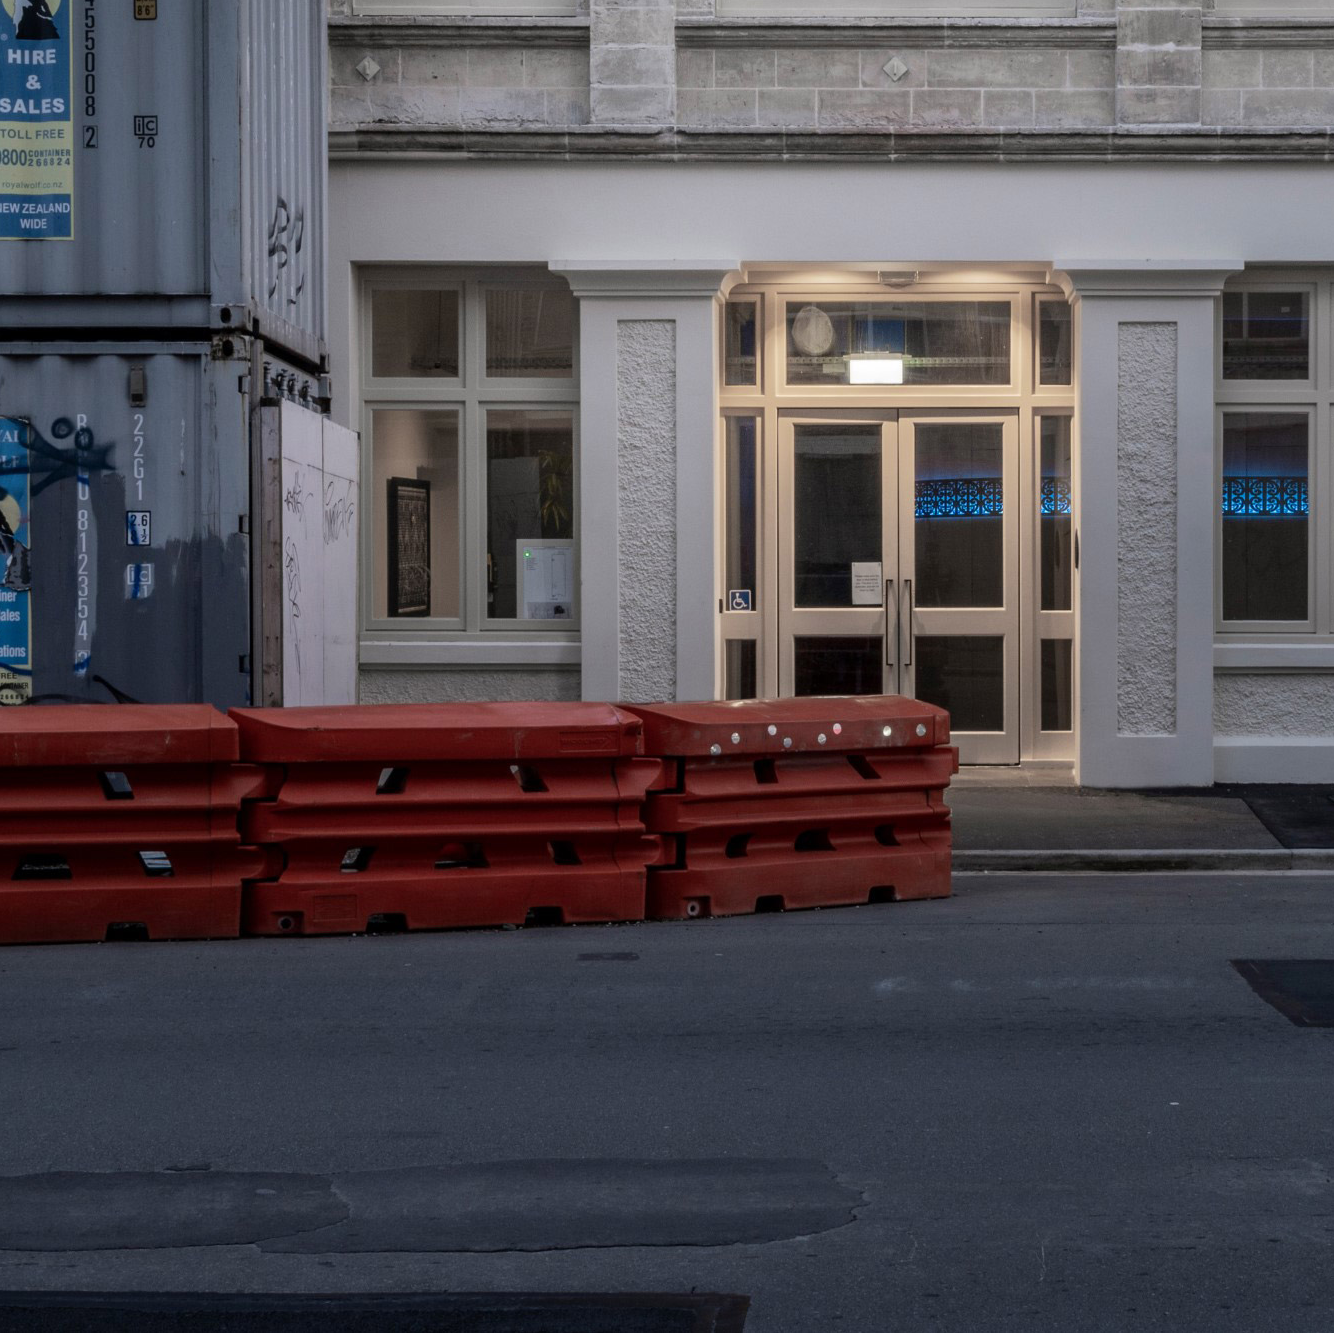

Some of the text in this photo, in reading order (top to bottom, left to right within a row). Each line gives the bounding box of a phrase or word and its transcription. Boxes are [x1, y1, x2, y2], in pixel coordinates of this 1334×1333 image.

[7, 48, 57, 65] HIRE
[25, 74, 42, 90] &
[0, 129, 65, 140] TOLL FREE
[85, 126, 97, 149] 2
[138, 137, 156, 148] 70
[28, 149, 71, 157] CONTAINER
[28, 158, 71, 167] 266824
[22, 203, 71, 214] ZEALAND
[19, 218, 48, 229] WIDE
[133, 413, 145, 501] 22G1
[77, 509, 88, 641] 812354
